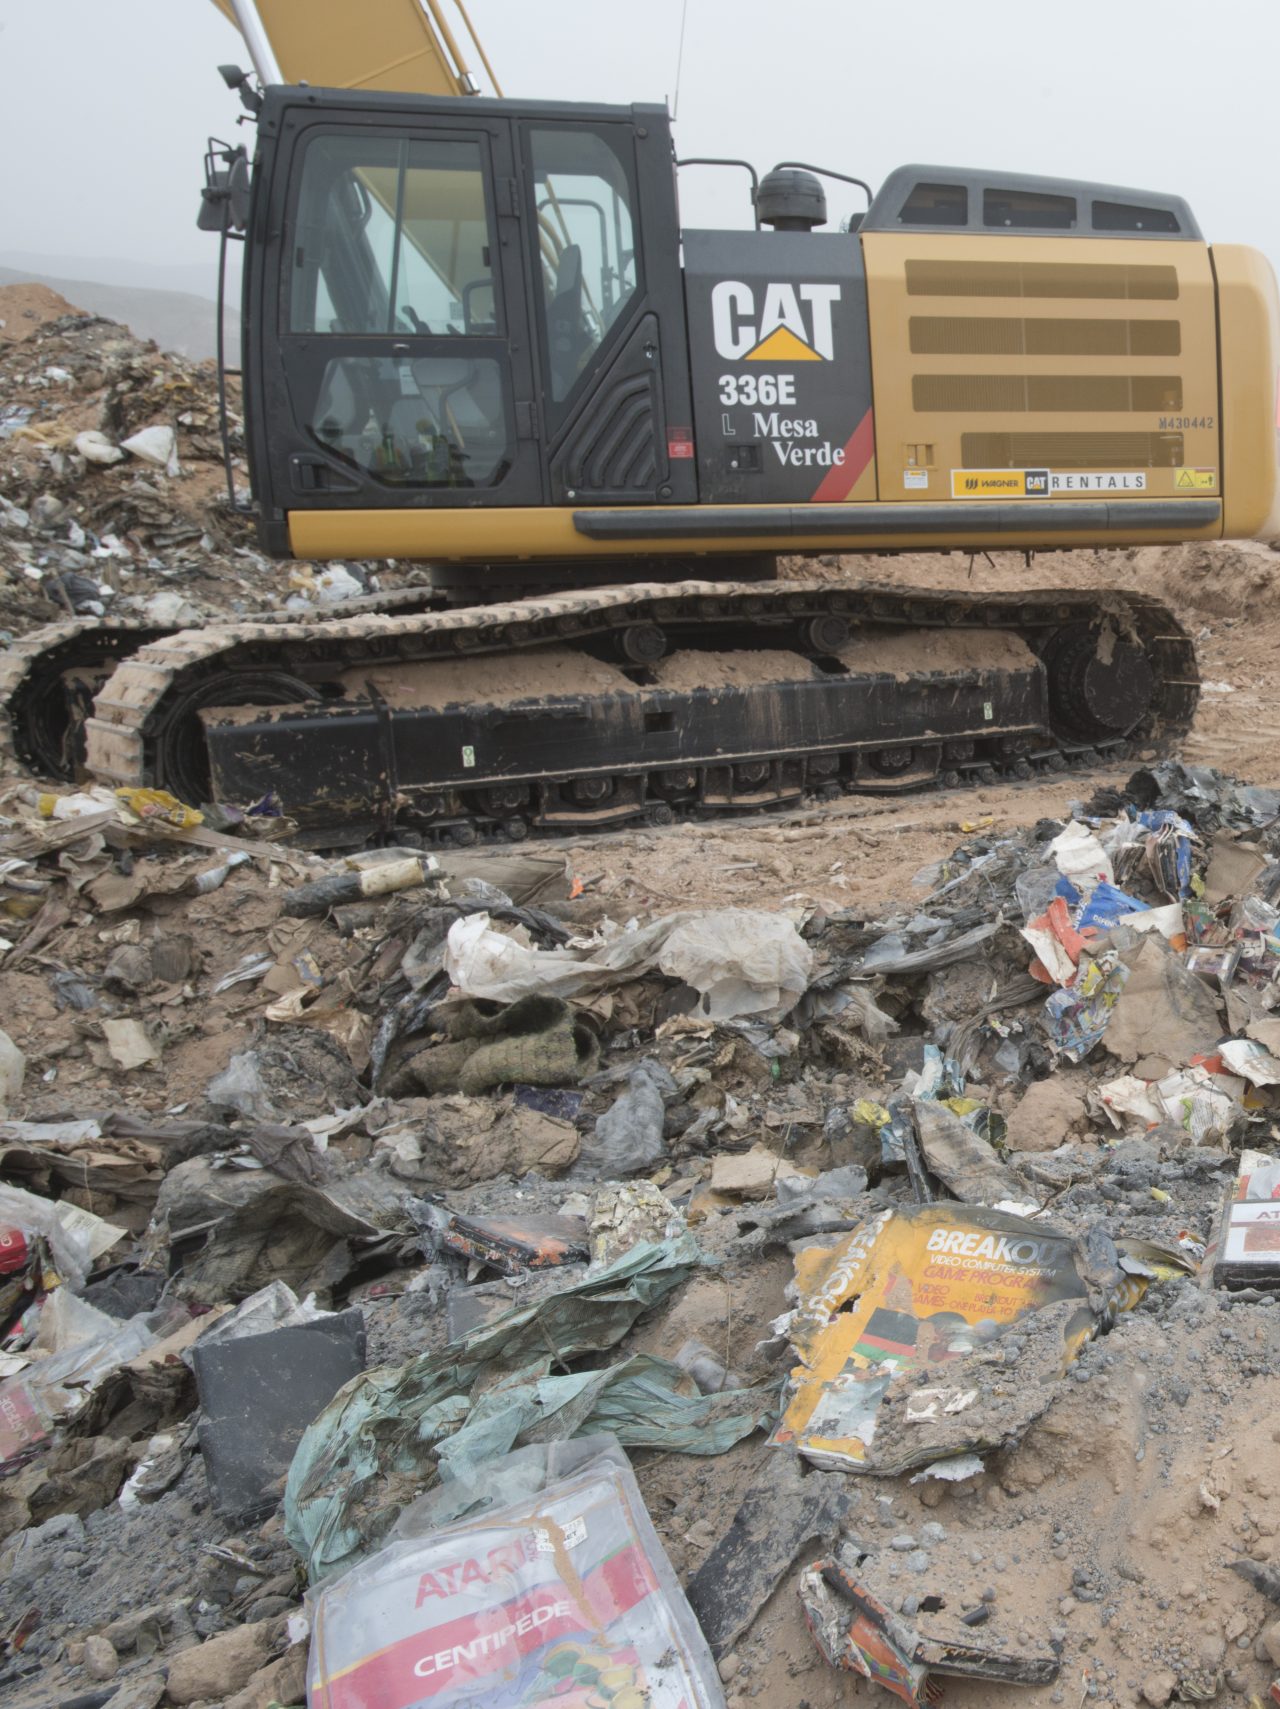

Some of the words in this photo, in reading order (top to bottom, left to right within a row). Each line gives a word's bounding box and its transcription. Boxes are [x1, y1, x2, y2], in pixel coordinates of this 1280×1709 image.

[711, 280, 841, 361] CAT
[718, 374, 797, 406] 336E
[722, 413, 736, 436] L
[752, 412, 819, 438] Mesa
[1158, 416, 1215, 430] M430442
[772, 441, 846, 467] Verde
[980, 478, 1019, 489] WAGNER
[1026, 475, 1046, 489] CAT
[1051, 475, 1144, 489] RENTALS
[926, 1228, 1064, 1266] BREAKOU
[922, 1265, 968, 1283] GAME
[929, 1253, 962, 1268] VIDEO
[962, 1257, 1017, 1275] COMPUTER
[415, 1538, 527, 1610] ATARI
[413, 1600, 571, 1678] CENTIPEDE
